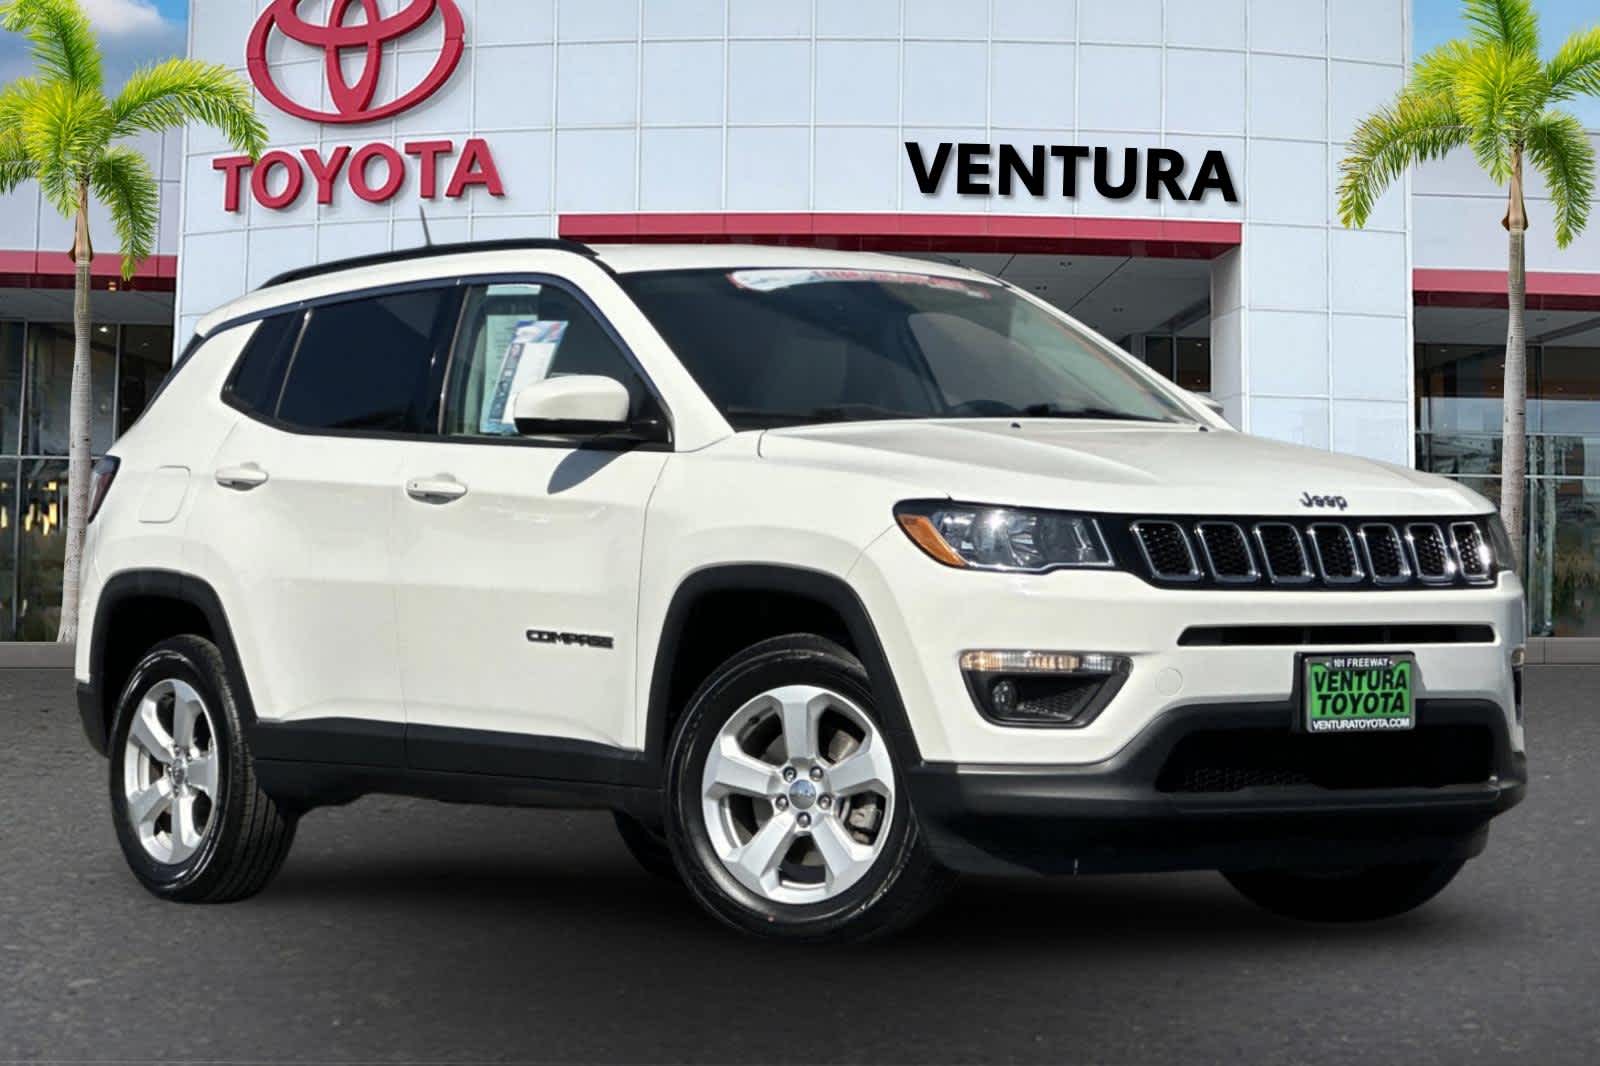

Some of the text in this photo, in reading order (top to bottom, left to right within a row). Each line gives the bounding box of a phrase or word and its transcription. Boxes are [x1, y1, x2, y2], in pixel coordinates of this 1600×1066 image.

[212, 138, 505, 212] TOYOTA
[904, 141, 1239, 203] VENTURA
[1299, 491, 1348, 511] Jeep
[526, 629, 614, 649] COMPASS
[1333, 658, 1389, 668] 101 FREEWAY
[1313, 669, 1408, 692] VENTURA
[1317, 691, 1406, 715] TOYOTA
[1312, 718, 1410, 730] VENTURATOYOTA.COM
